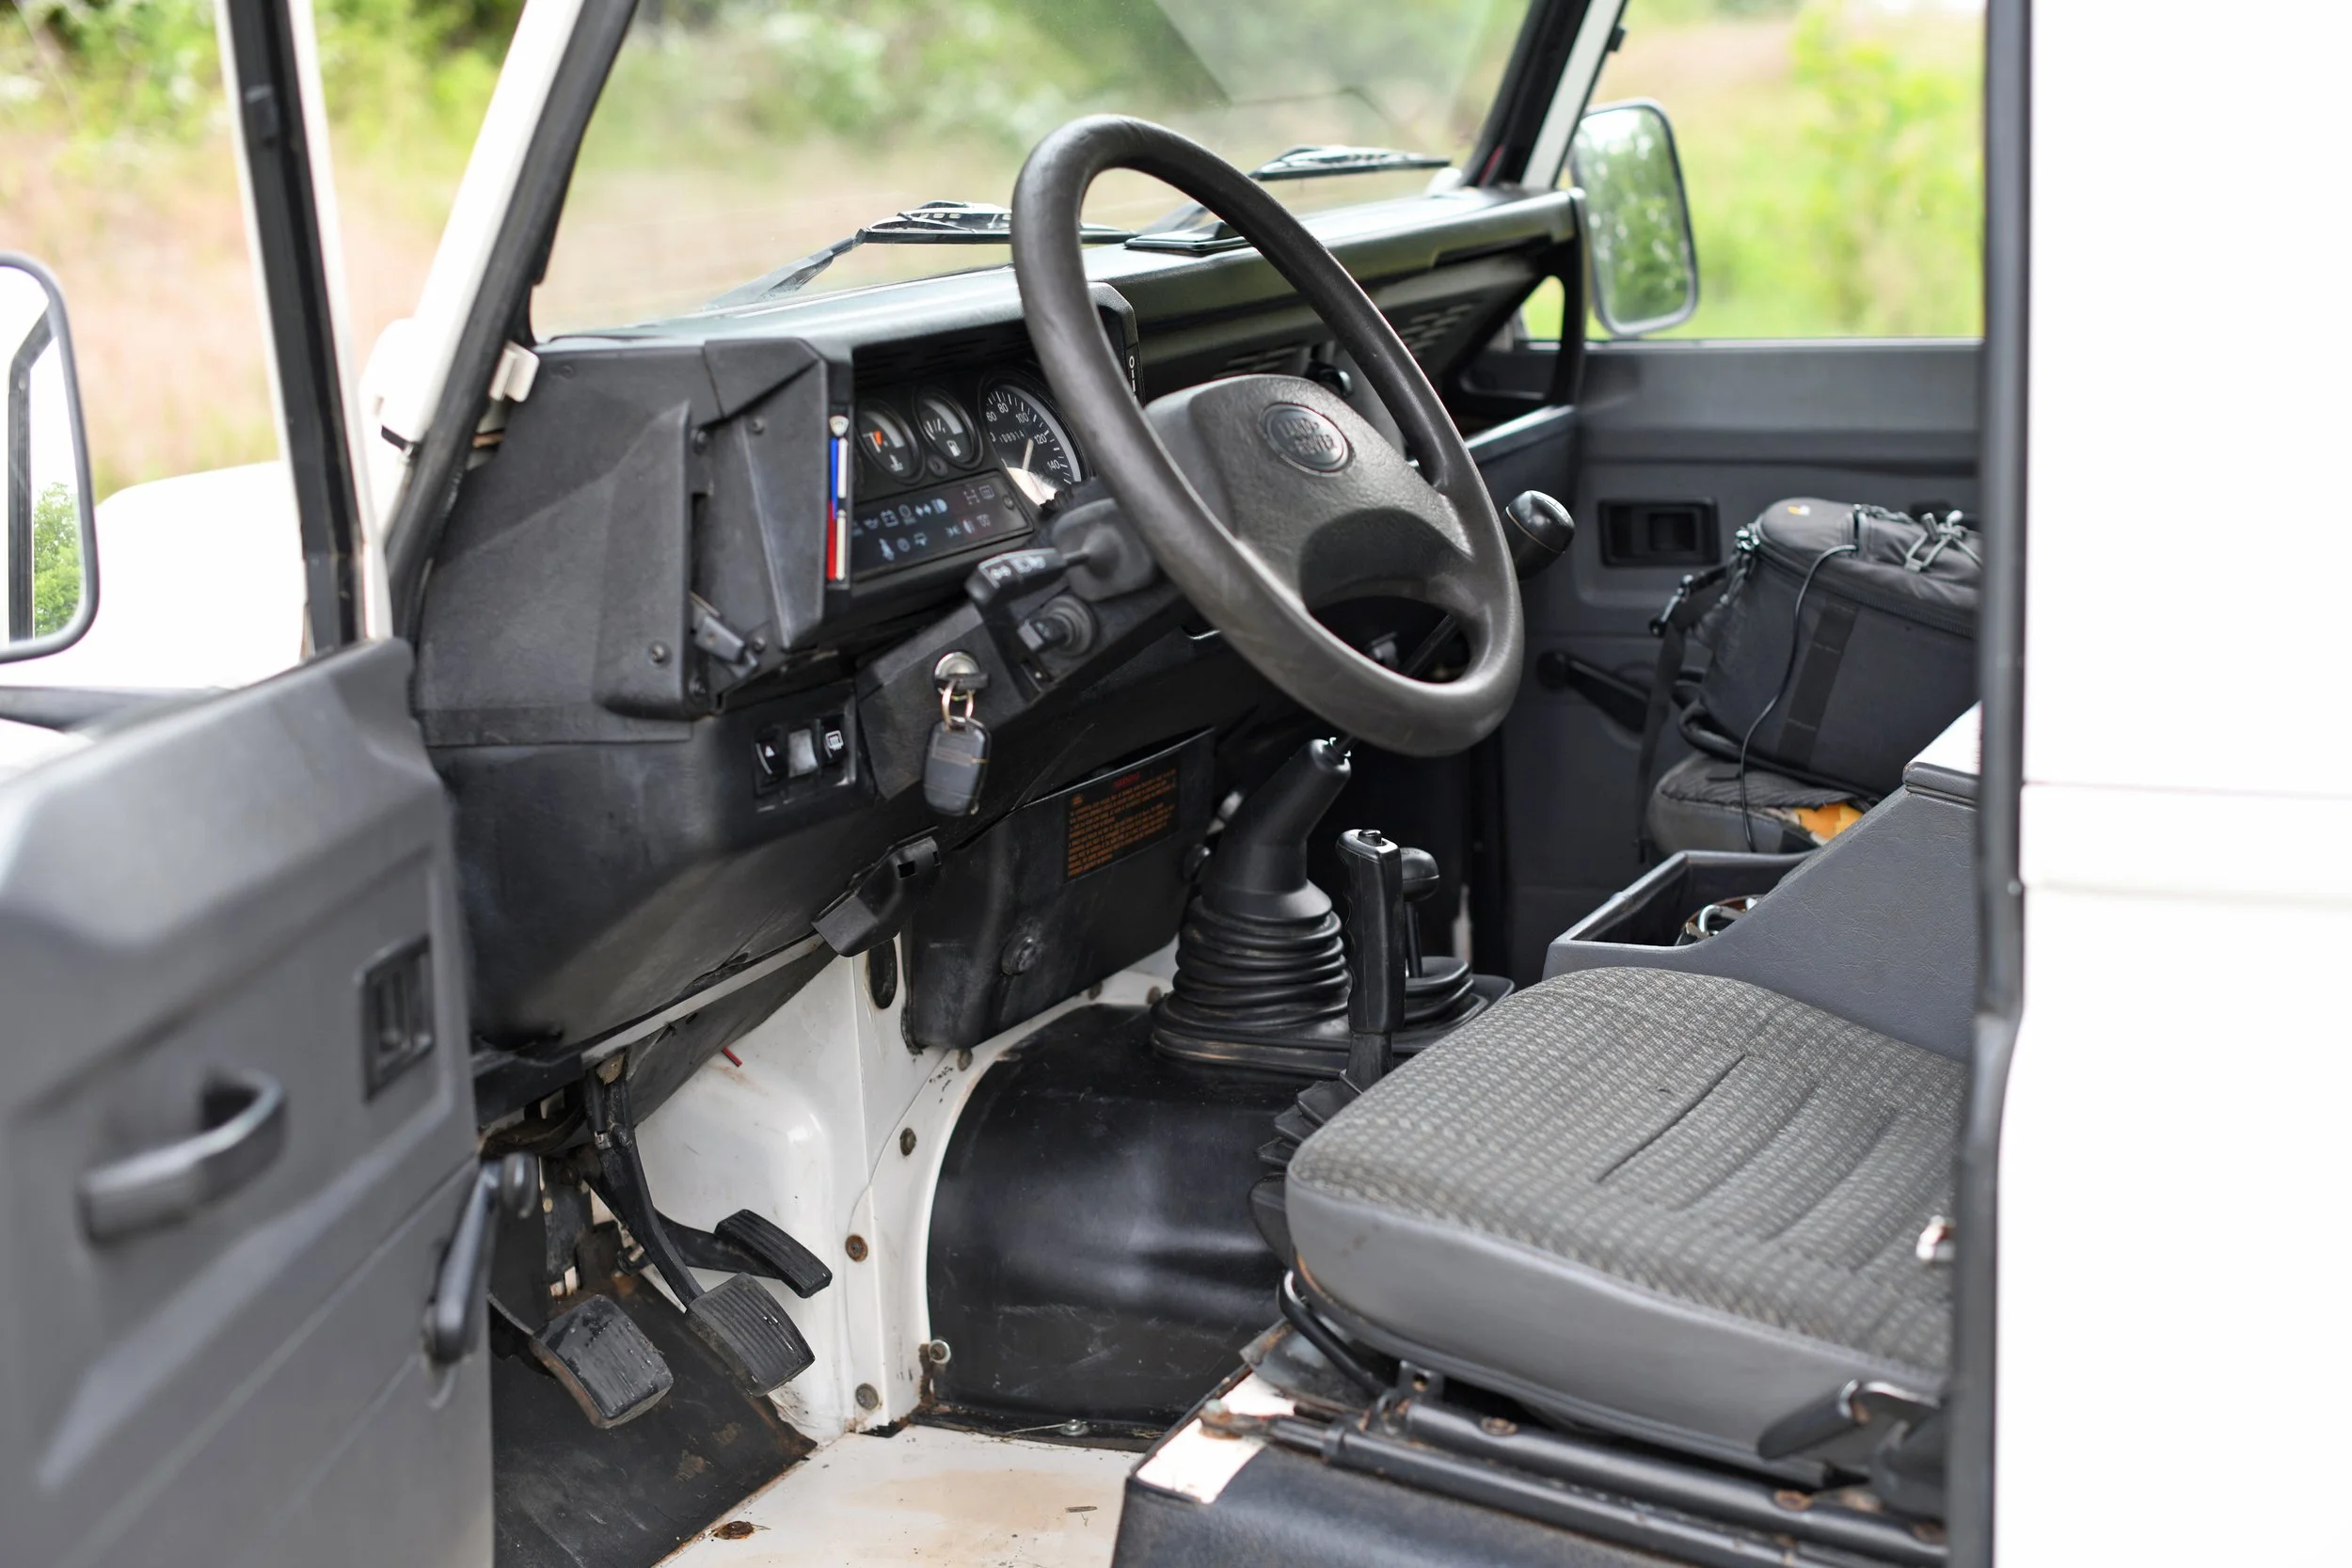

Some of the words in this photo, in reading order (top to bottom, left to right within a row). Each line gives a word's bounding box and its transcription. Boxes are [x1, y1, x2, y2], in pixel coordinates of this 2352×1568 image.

[997, 403, 1009, 414] 80
[986, 411, 996, 421] 60
[1016, 413, 1029, 424] 100
[1035, 434, 1047, 444] 120
[1047, 459, 1060, 470] 140
